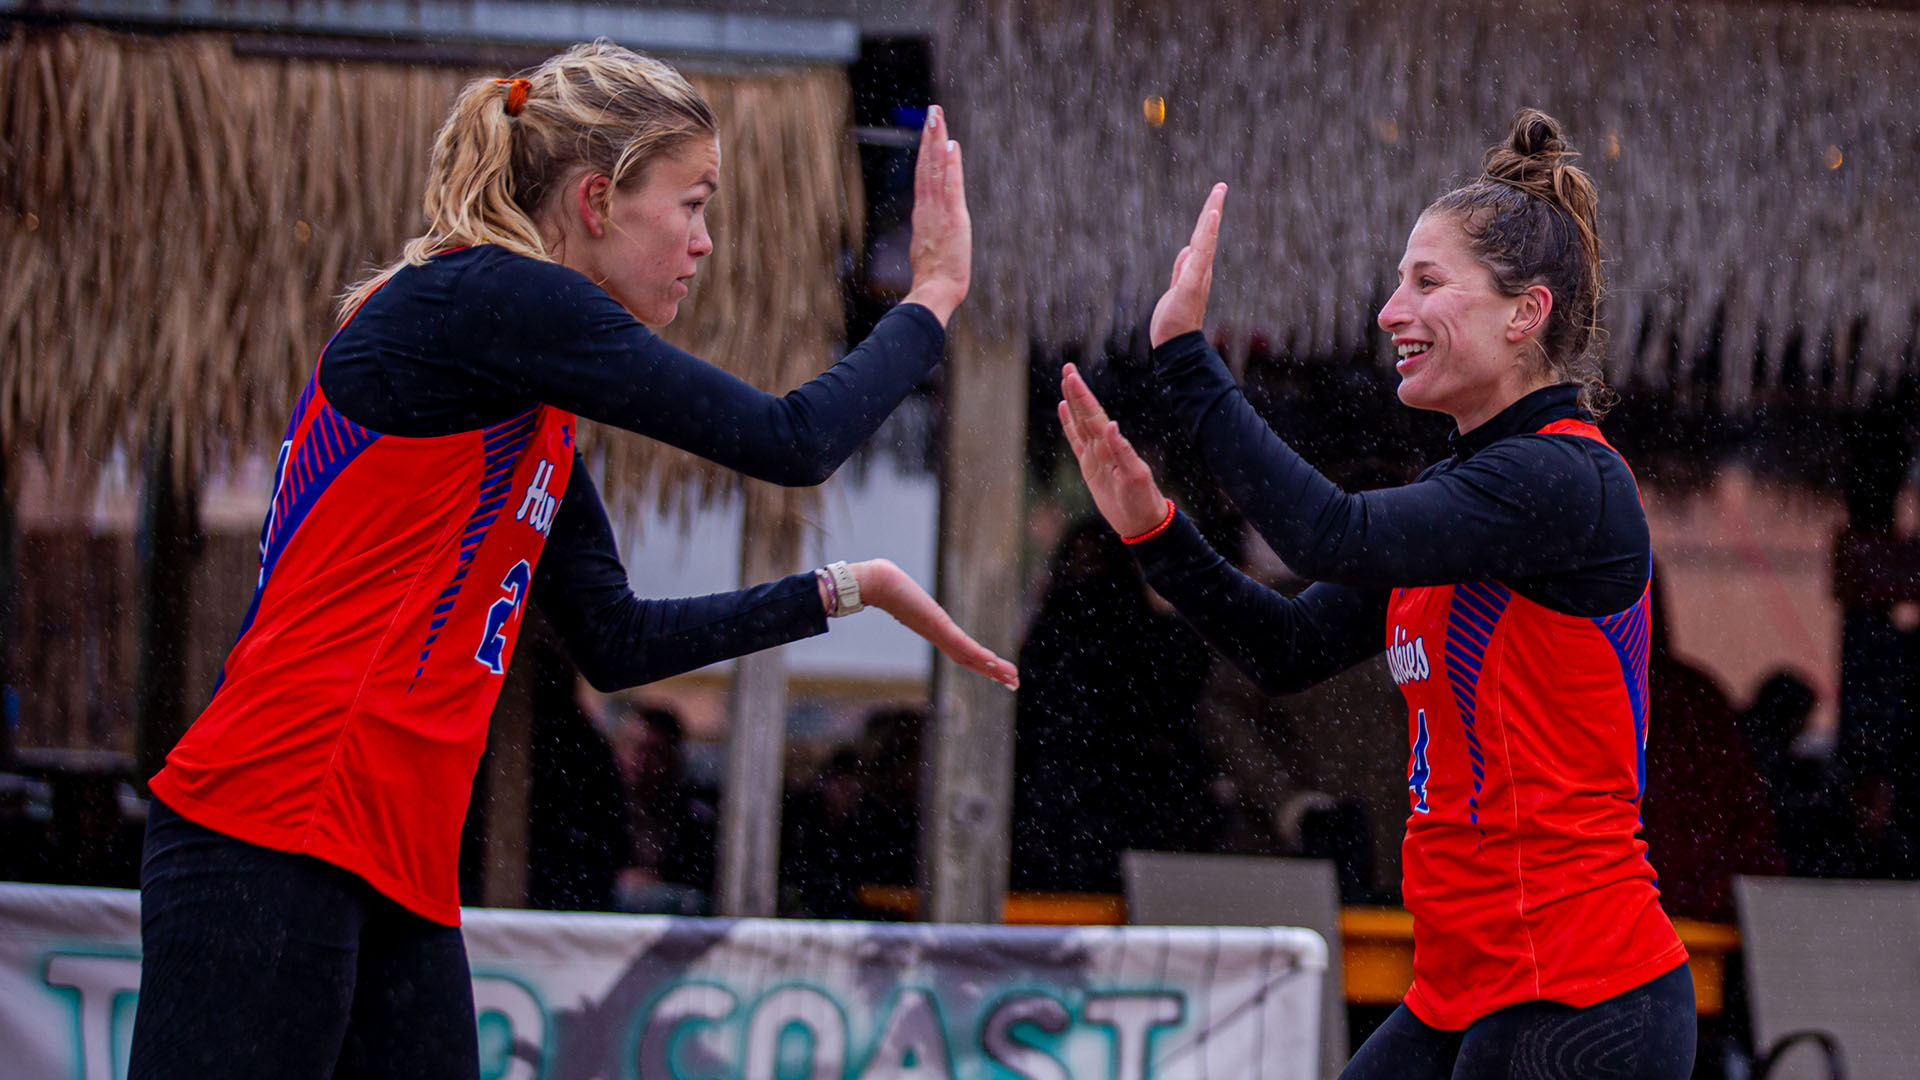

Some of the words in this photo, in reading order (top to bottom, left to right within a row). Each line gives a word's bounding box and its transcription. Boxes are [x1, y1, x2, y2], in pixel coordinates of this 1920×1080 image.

[474, 558, 531, 675] 2
[1409, 708, 1430, 814] 4
[636, 980, 1186, 1080] COAST
